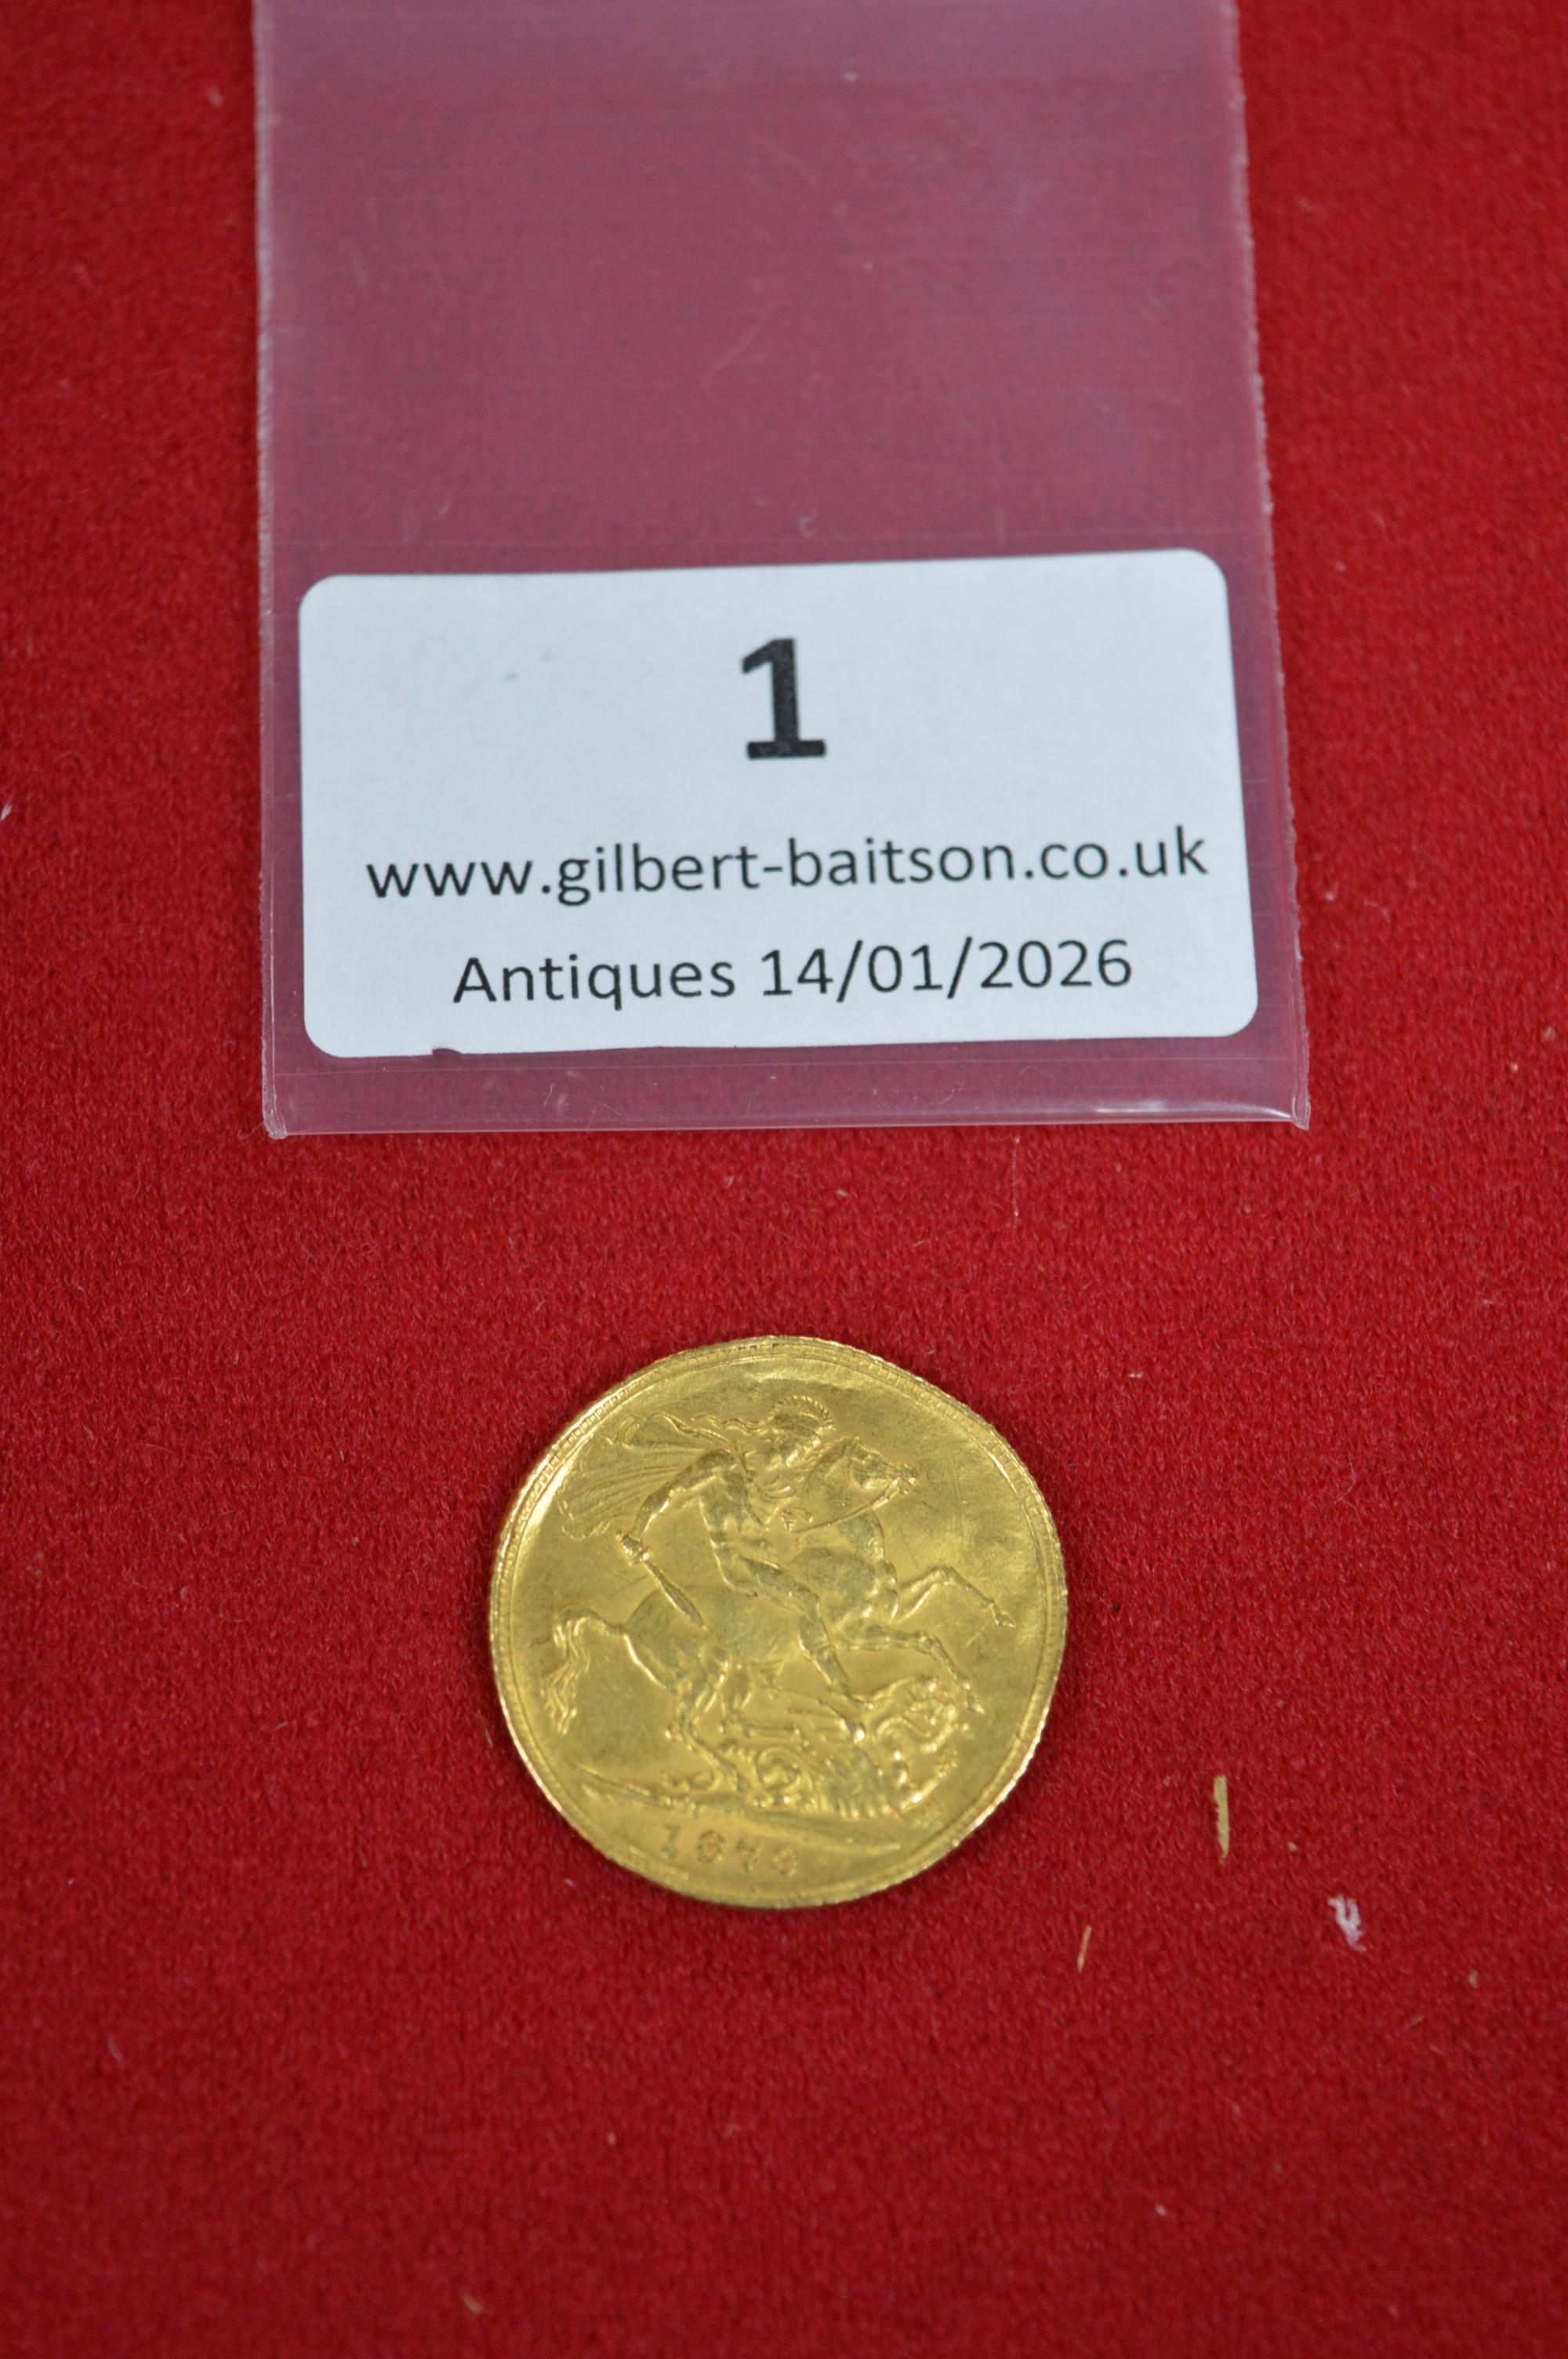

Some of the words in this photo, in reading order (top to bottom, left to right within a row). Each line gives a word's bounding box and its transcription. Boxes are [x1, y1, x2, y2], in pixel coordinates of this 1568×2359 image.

[741, 638, 826, 761] 1
[366, 825, 1207, 907] www.gilbert-baitson.co.uk
[452, 954, 735, 1011] Antiques
[761, 936, 1131, 1003] 14/01/2026
